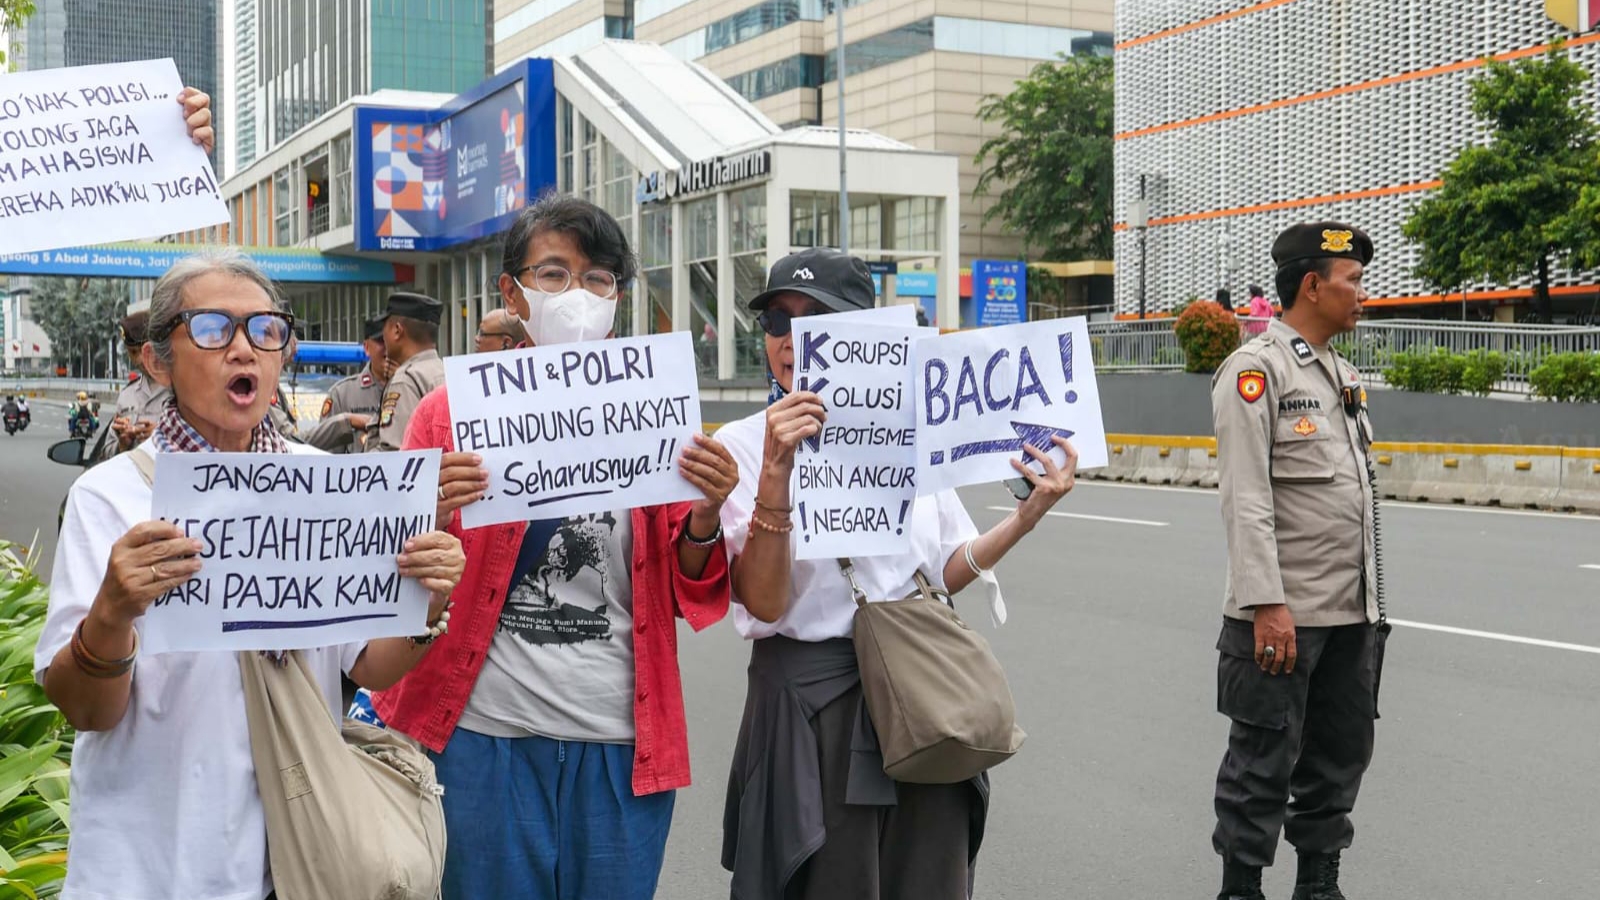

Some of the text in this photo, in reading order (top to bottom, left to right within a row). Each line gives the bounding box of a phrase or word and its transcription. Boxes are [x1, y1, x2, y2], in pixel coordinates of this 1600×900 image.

[0, 91, 78, 120] O'NAK
[83, 114, 139, 140] JAGA
[0, 142, 154, 183] MAHASISWA
[152, 165, 220, 203] JUGA!
[43, 252, 51, 263] 5
[55, 252, 88, 265] Abad
[91, 254, 144, 269] Jakarta,
[469, 356, 538, 398] TNI
[562, 345, 655, 388] POLRI
[924, 345, 1053, 426] BACA
[456, 395, 691, 452] PELINDUNG RAKYAT
[193, 462, 314, 494] JANGAN
[325, 464, 388, 494] LUPA
[848, 466, 916, 490] ANCUR
[160, 513, 431, 561] ESEJAHTERAANM
[223, 573, 323, 609] PAJAK
[336, 571, 400, 605] KAMI
